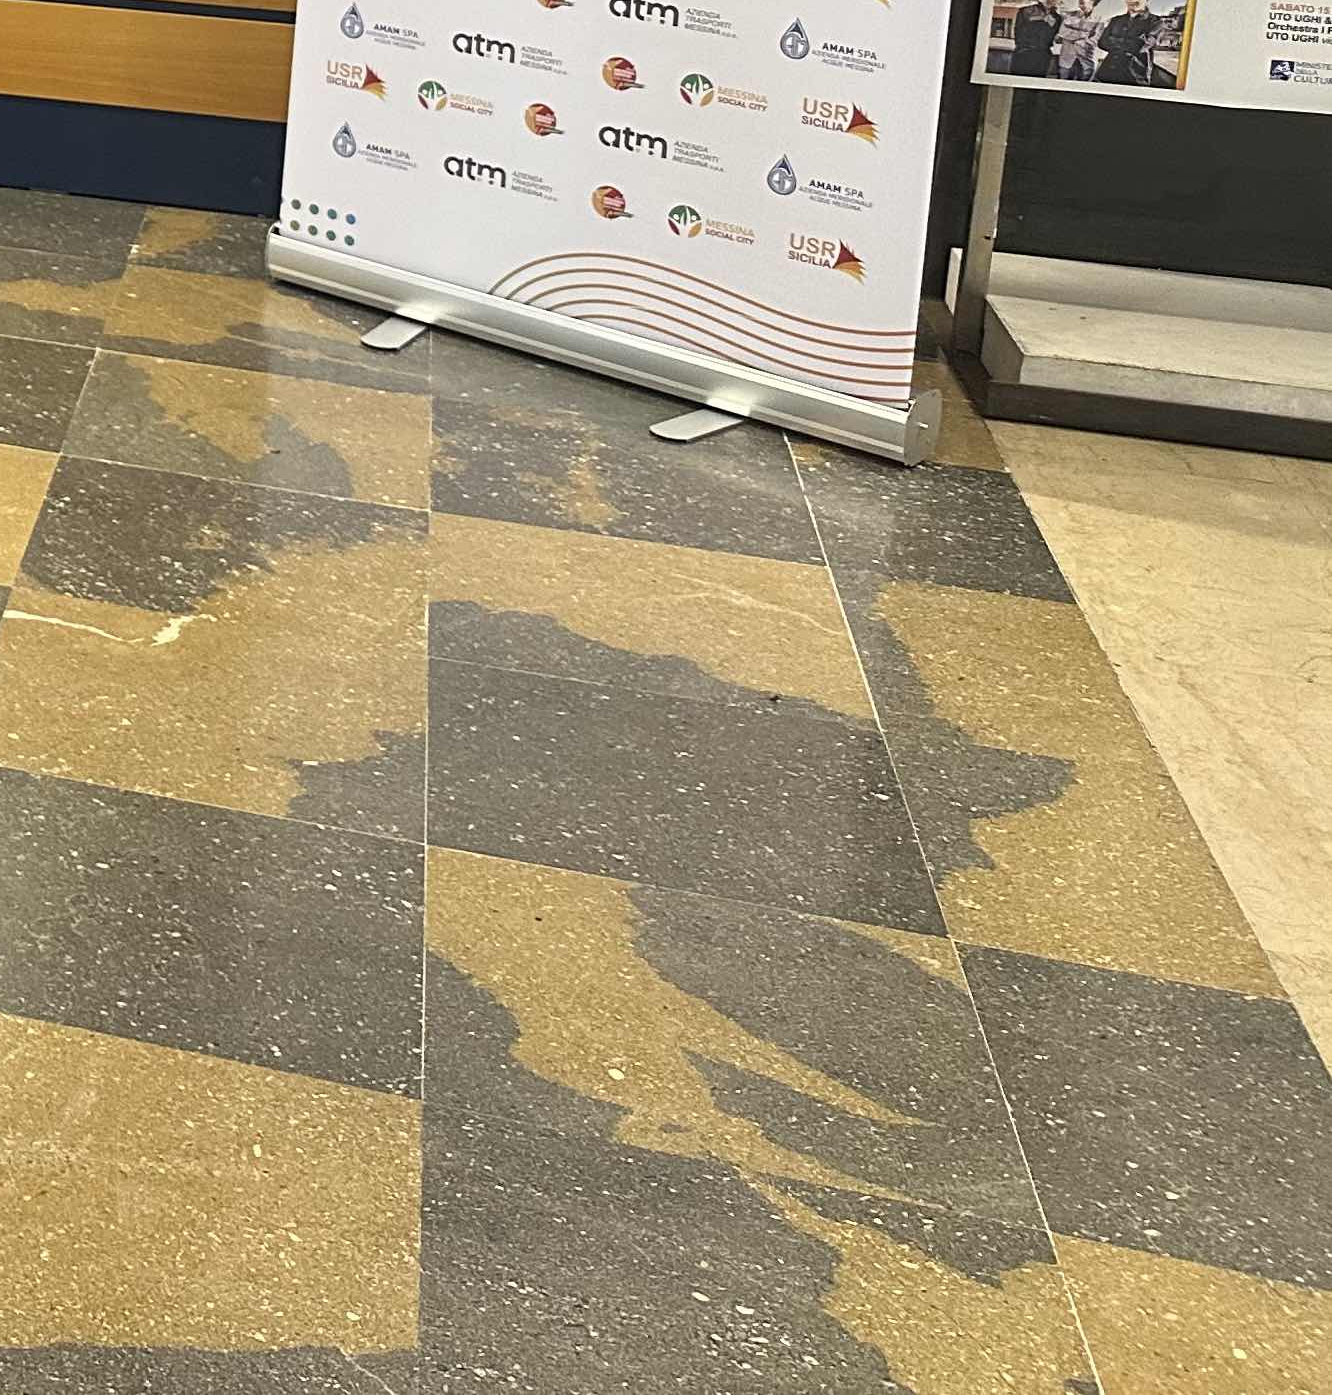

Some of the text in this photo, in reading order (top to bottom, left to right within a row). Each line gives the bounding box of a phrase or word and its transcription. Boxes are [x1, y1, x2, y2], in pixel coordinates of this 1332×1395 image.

[1271, 3, 1315, 13] SABATO
[1269, 12, 1292, 21] UTO
[1294, 14, 1321, 24] UGHI
[1268, 22, 1319, 34] Orchestra
[1266, 32, 1289, 41] UTO
[1292, 34, 1319, 43] UGHI
[452, 33, 515, 63] atm
[822, 42, 877, 60] AMAM SPA
[327, 59, 363, 80] USR
[326, 75, 360, 89] SICILIA
[716, 85, 768, 103] MESSINA
[717, 96, 767, 112] SOCIAL CITY
[802, 97, 849, 123] USR
[801, 115, 844, 133] SICILIA
[598, 126, 667, 158] atm
[443, 156, 506, 188] atm
[809, 179, 864, 199] AMAM SPA
[705, 218, 755, 238] MESSINA
[705, 228, 754, 245] SOCIAL CITY
[790, 233, 837, 258] USR
[788, 250, 831, 269] SICILIA
